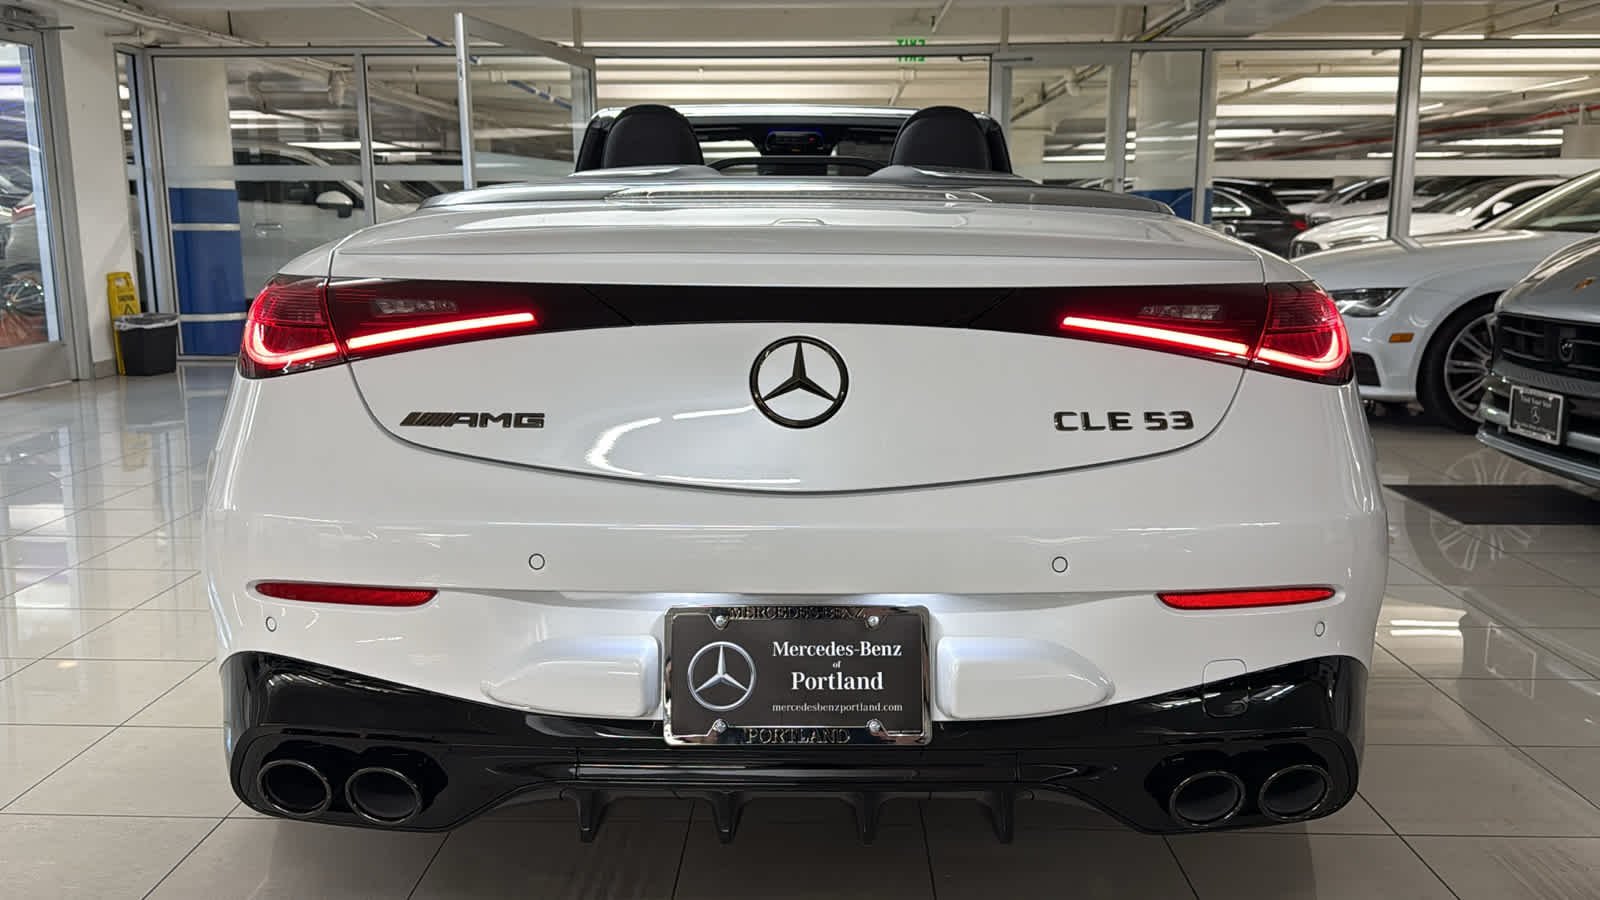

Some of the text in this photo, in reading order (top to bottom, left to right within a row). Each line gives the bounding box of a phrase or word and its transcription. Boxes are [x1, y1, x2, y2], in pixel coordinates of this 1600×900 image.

[449, 412, 545, 428] AMG
[1053, 410, 1194, 431] CLE 53
[772, 641, 903, 657] Mercedes-Benz
[832, 660, 841, 669] of
[791, 671, 884, 690] Portland
[772, 702, 903, 713] mercedesbenzportland.com
[746, 728, 851, 744] PORTLAND
